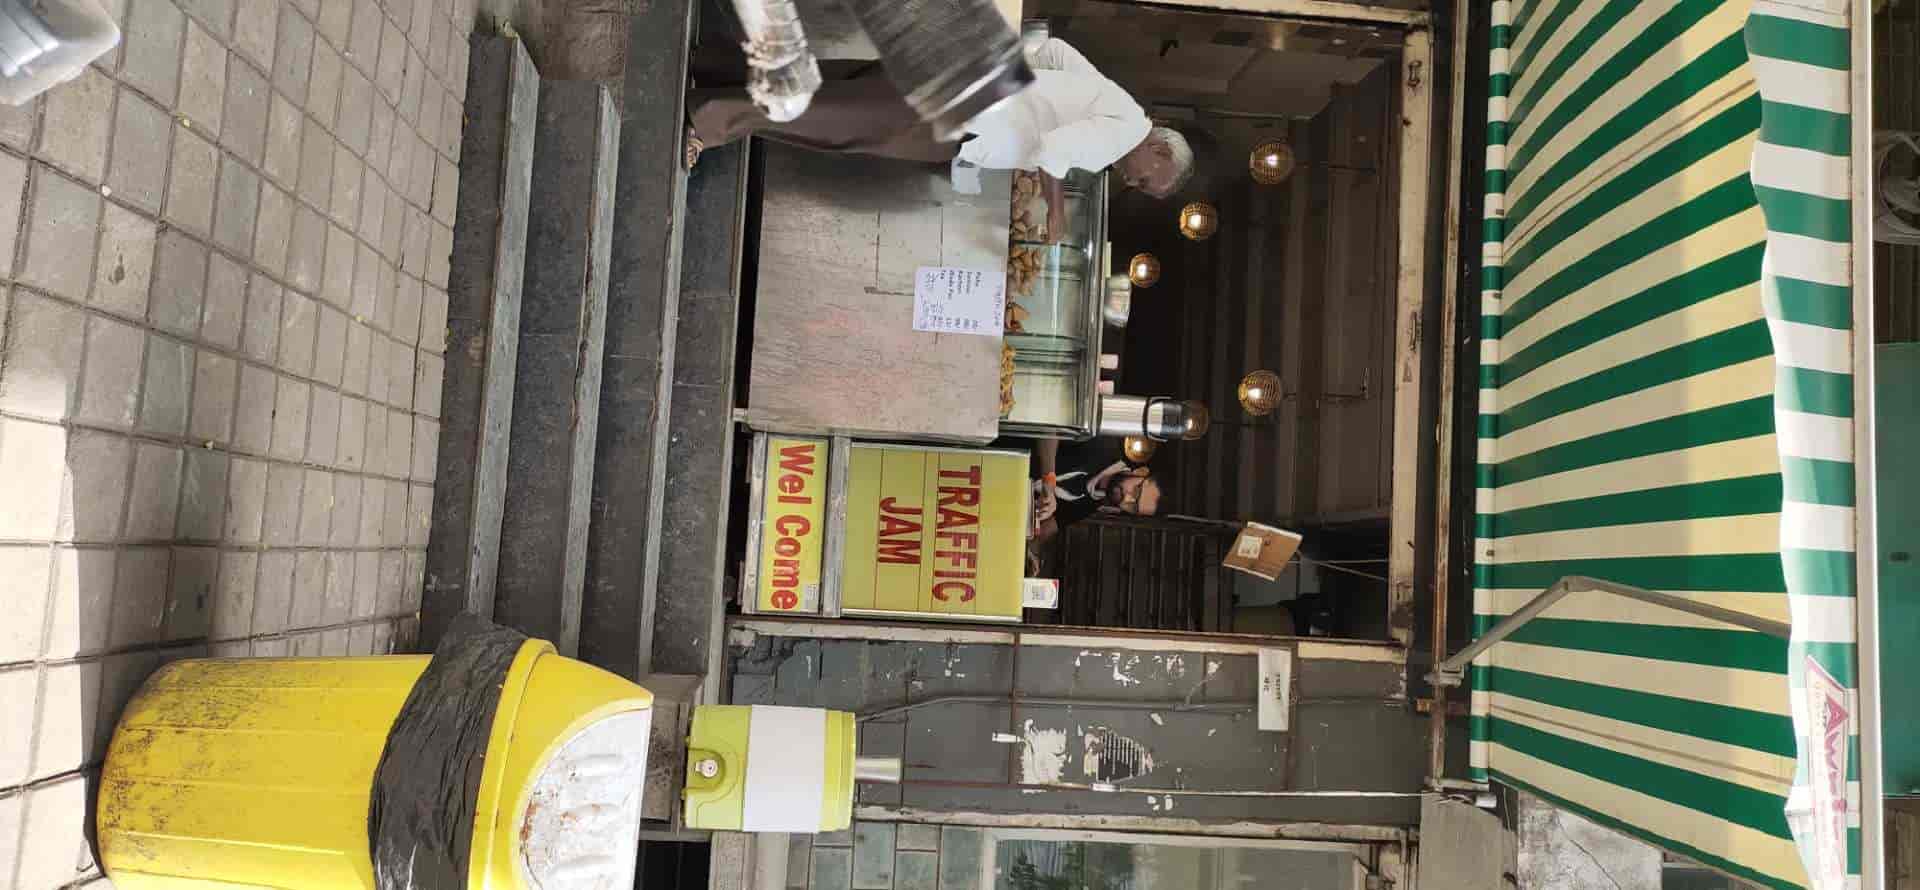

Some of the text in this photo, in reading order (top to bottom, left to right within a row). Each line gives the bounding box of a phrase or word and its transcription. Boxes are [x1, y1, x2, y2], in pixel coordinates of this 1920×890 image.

[771, 444, 816, 610] Wel Come
[877, 496, 923, 565] JAM
[932, 465, 982, 602] TRAFFIC
